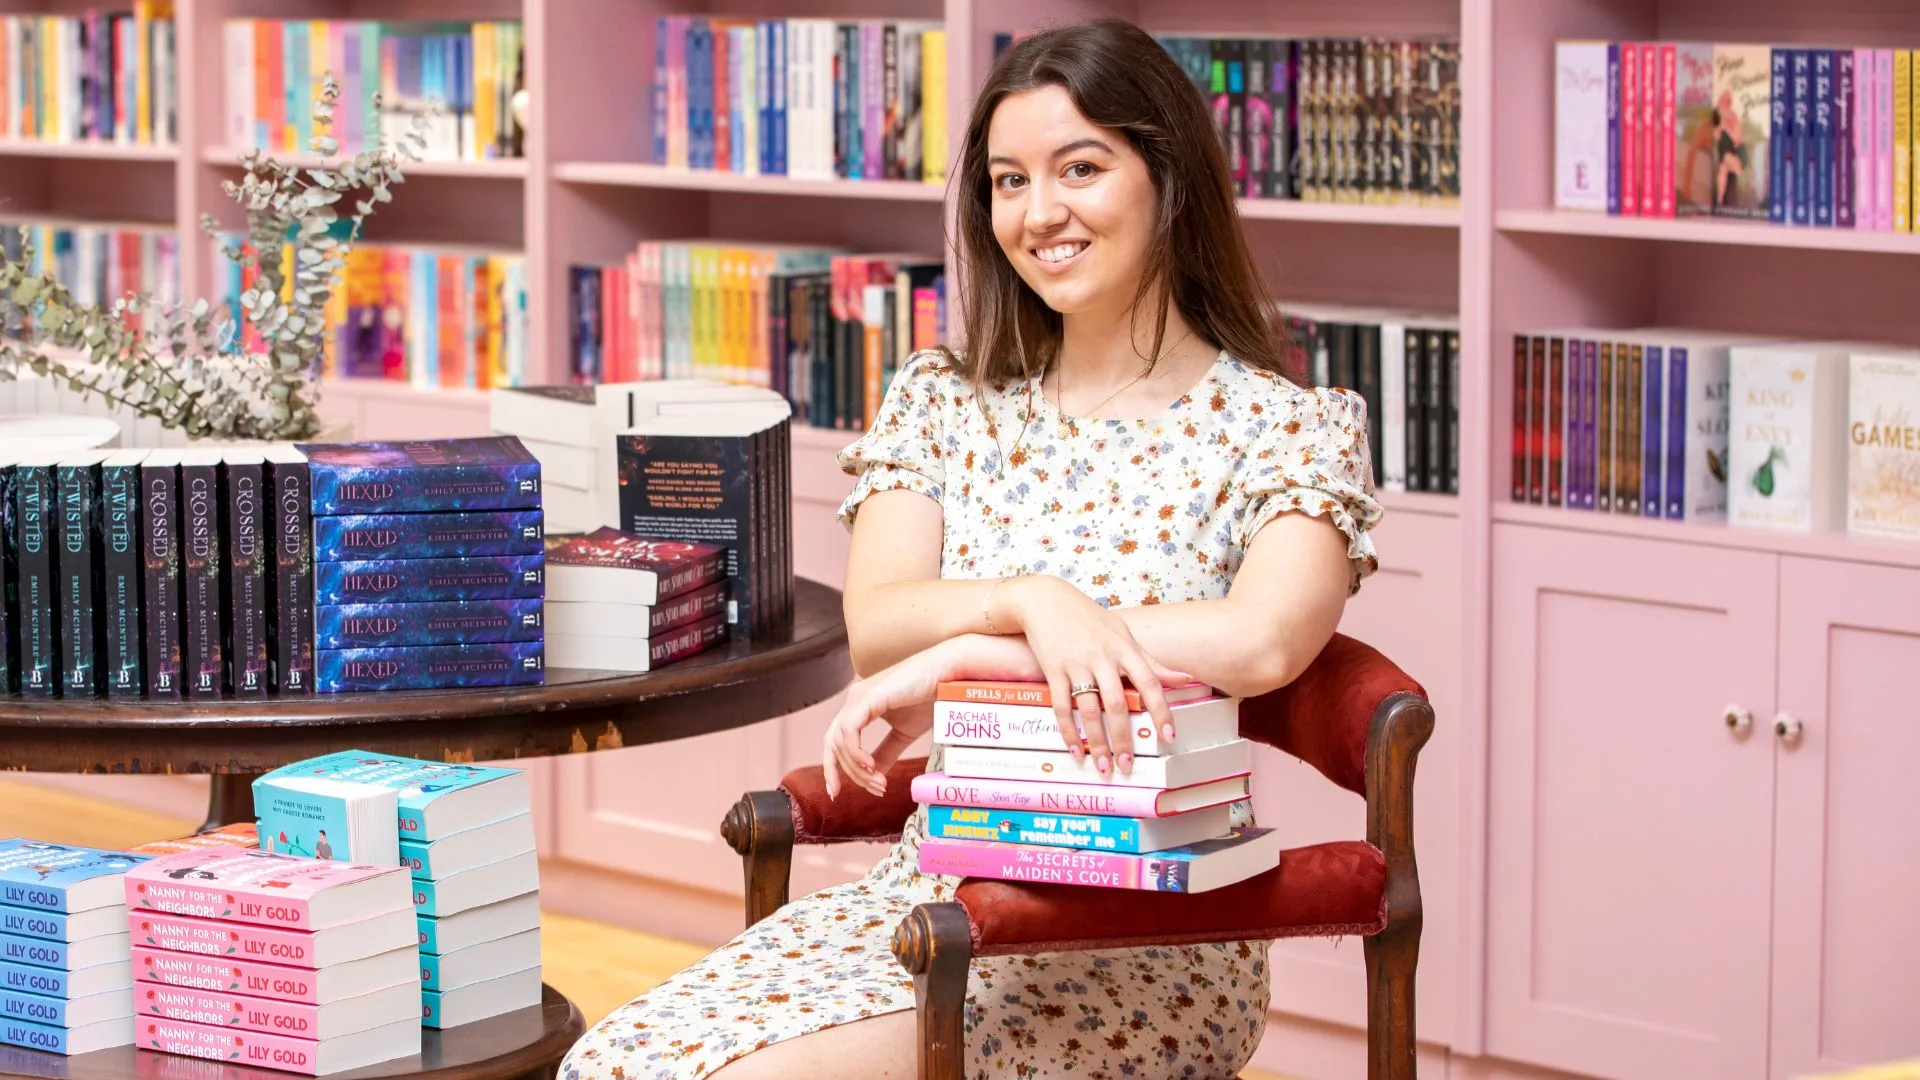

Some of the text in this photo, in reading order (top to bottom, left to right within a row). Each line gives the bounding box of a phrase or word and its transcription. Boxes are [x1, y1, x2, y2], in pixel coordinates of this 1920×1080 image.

[1851, 422, 1920, 450] GAME
[340, 484, 393, 500] HEXED
[424, 486, 506, 496] EMILY MCINTIRE
[25, 481, 44, 553] TWISTED
[65, 481, 84, 553] TWISTED
[111, 481, 130, 553] TWISTED
[150, 479, 168, 557] CROSSED
[190, 478, 208, 556] CROSSED
[237, 477, 254, 555] CROSSED
[282, 476, 300, 554] CROSSED
[343, 530, 397, 547] HEXED
[428, 533, 509, 542] EMILY MCINTIRE
[30, 575, 38, 605] EMILY
[289, 574, 297, 604] EMILY
[344, 574, 398, 592] HEXED
[429, 577, 510, 586] EMILY MCINTIRE
[343, 618, 397, 635] HEXED
[428, 620, 509, 630] EMILY MCINTIRE
[345, 661, 398, 679] HEXED
[429, 664, 509, 673] EMILY MCINTIRE
[966, 688, 1043, 702] SPELLS for LOVE
[949, 710, 999, 722] RACHAEL
[945, 722, 1001, 739] JOHNS
[1008, 722, 1020, 732] The
[1021, 719, 1050, 735] Other
[936, 786, 979, 804] LOVE
[1012, 792, 1031, 806] Faye
[1041, 793, 1060, 809] IN
[1066, 794, 1116, 812] EXILE
[302, 812, 325, 821] ROMANCE
[951, 810, 990, 823] ABBY
[1034, 817, 1101, 833] say you'll
[943, 824, 999, 840] JIMENEZ
[1020, 829, 1116, 848] remember me
[1016, 850, 1034, 863] The
[1036, 852, 1096, 868] SECRETS
[1002, 865, 1120, 886] MAIDEN'S COVE
[6, 887, 58, 907] LILY GOLD
[149, 885, 223, 904] NANNY FOR THE
[157, 900, 216, 918] NEIGHBORS
[240, 902, 300, 922] LILY GOLD
[6, 915, 58, 935] LILY GOLD
[153, 923, 227, 941] NANNY FOR THE
[6, 942, 59, 963] LILY GOLD
[162, 938, 220, 956] NEIGHBORS
[244, 940, 304, 959] LILY GOLD
[156, 958, 230, 977] NANNY FOR THE
[7, 971, 60, 992] LILY GOLD
[165, 973, 223, 991] NEIGHBORS
[248, 976, 308, 996] LILY GOLD
[6, 999, 57, 1020] LILY GOLD
[158, 992, 231, 1011] NANNY FOR THE
[167, 1008, 224, 1026] NEIGHBORS
[249, 1011, 308, 1031] LILY GOLD
[8, 1027, 59, 1048] LILY GOLD
[159, 1026, 231, 1046] NANNY FOR THE
[167, 1043, 223, 1061] NEIGHBORS
[248, 1046, 307, 1066] LILY GOLD
